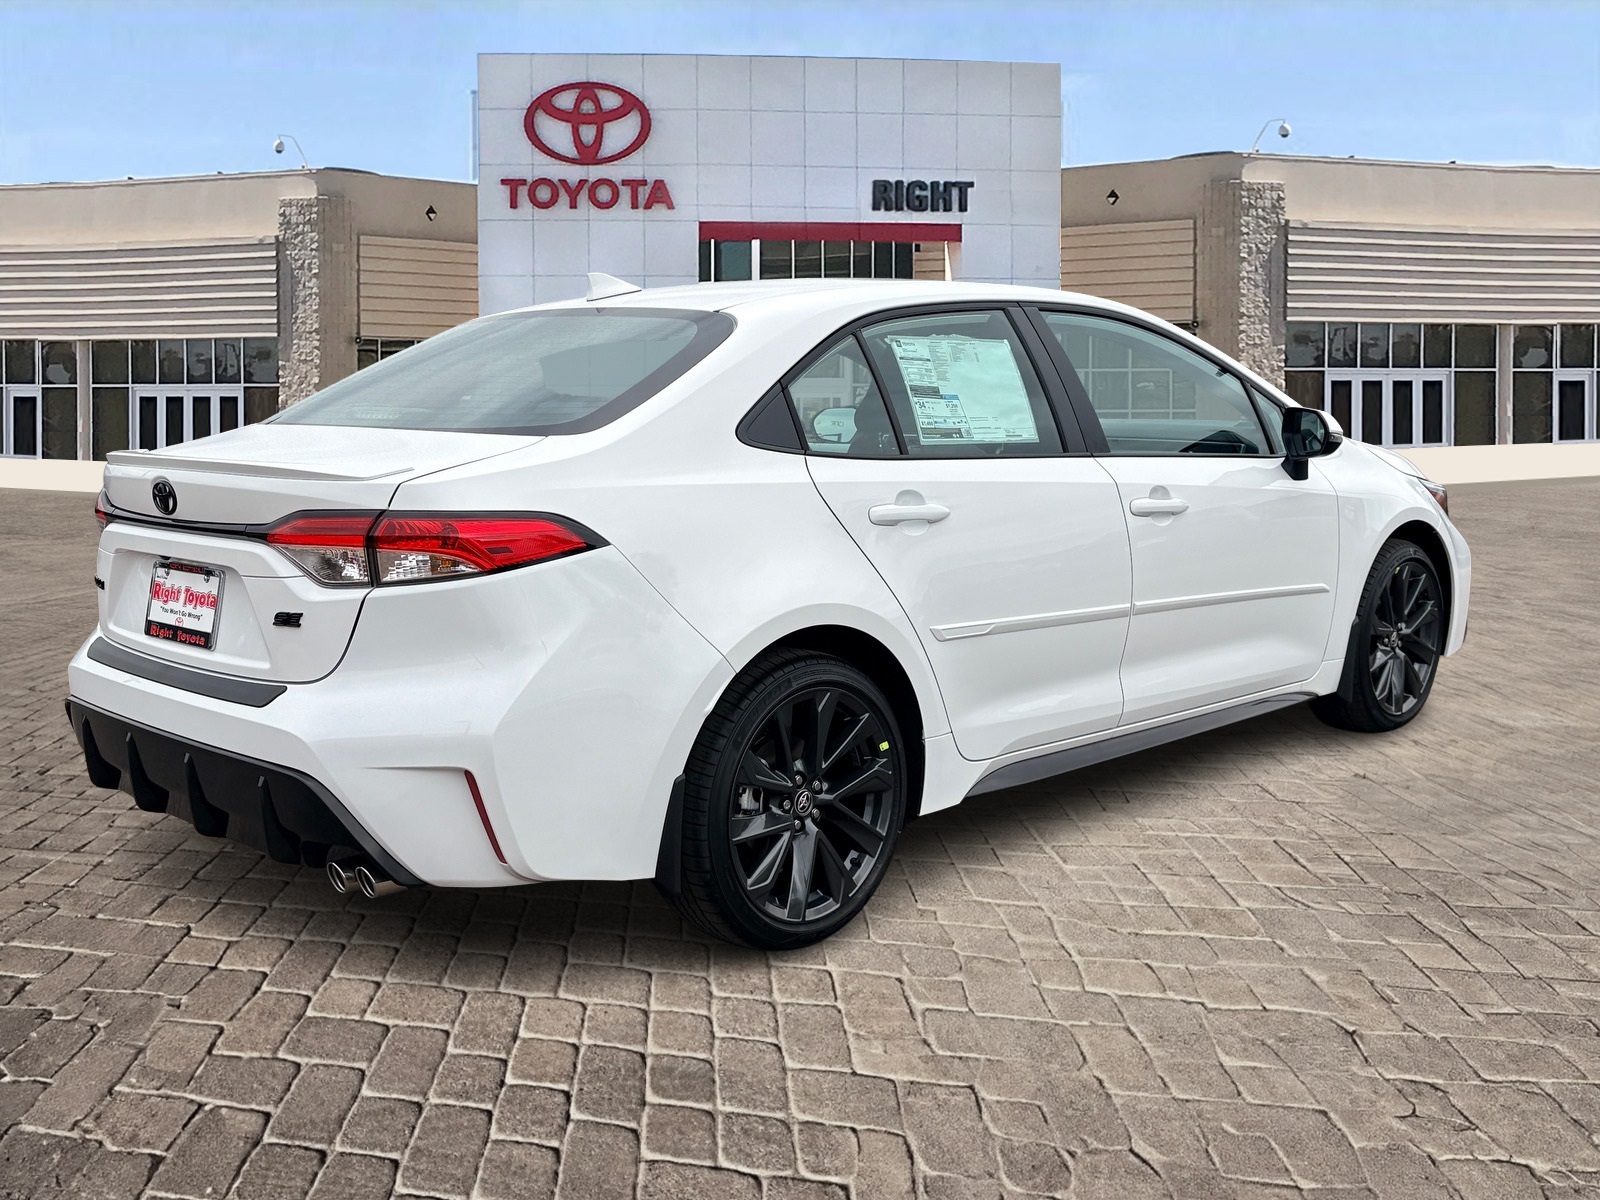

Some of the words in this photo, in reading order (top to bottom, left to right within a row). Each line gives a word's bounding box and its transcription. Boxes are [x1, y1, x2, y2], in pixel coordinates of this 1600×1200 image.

[500, 177, 675, 210] TOYOTA
[872, 180, 975, 212] RIGHT
[153, 581, 182, 605] Right
[183, 586, 218, 610] Toyota
[170, 608, 182, 616] Won't
[272, 611, 303, 628] SE
[150, 624, 173, 639] Right
[177, 630, 206, 646] Toyota
